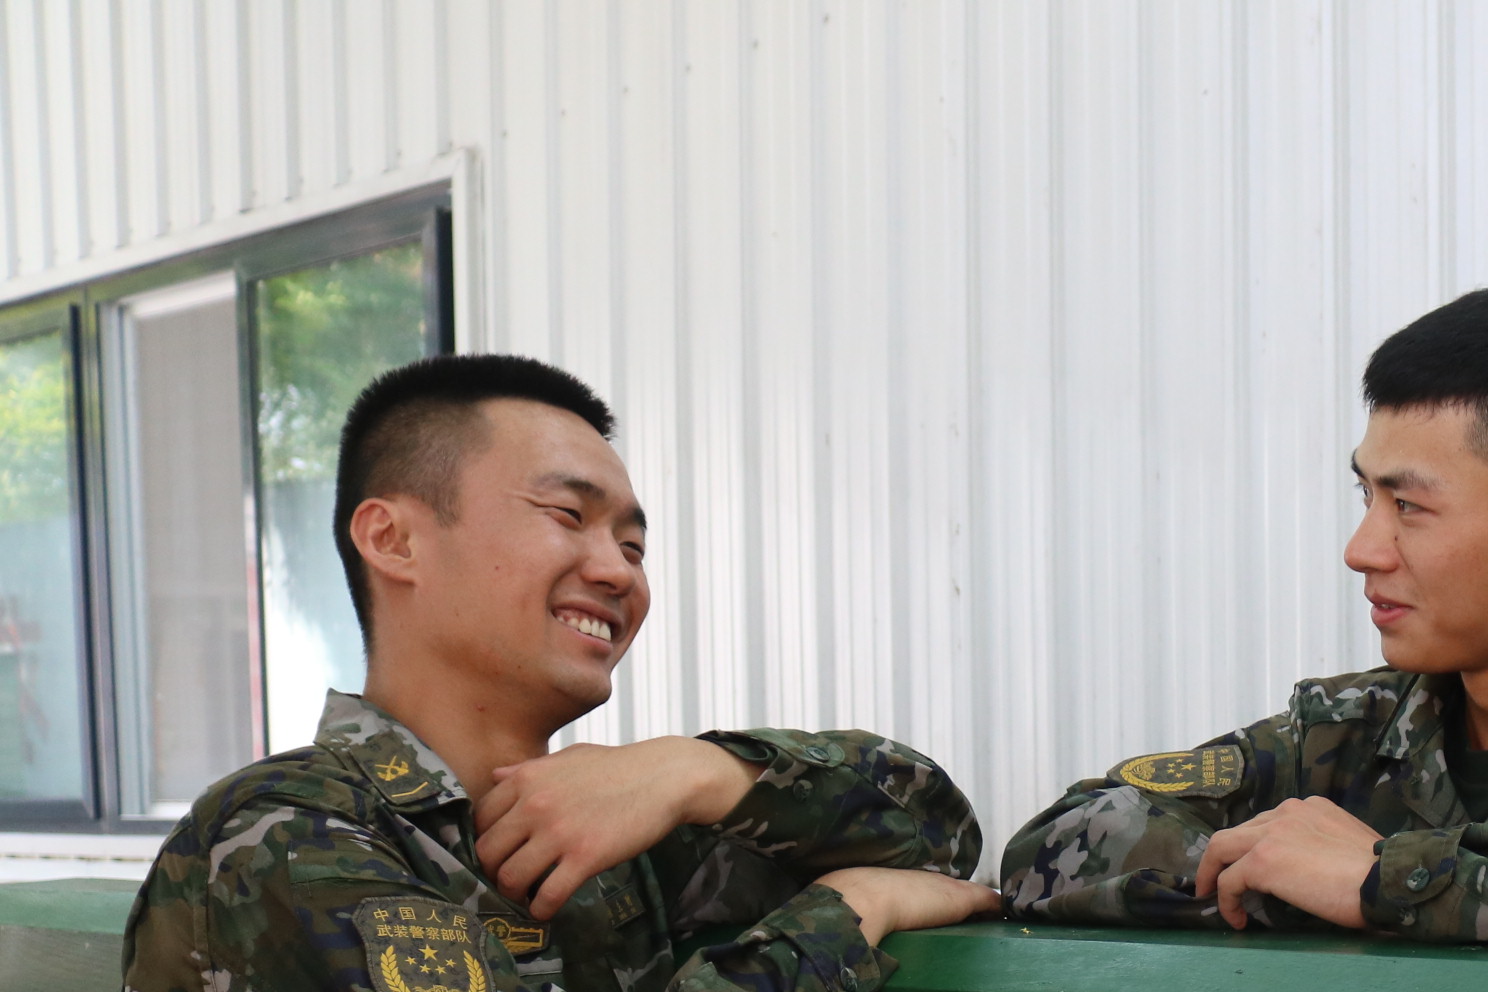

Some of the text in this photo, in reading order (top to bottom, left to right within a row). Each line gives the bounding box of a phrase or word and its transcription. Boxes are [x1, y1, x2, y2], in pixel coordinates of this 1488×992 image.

[373, 906, 468, 930] 中国人民
[376, 923, 472, 944] 武装警察部队
